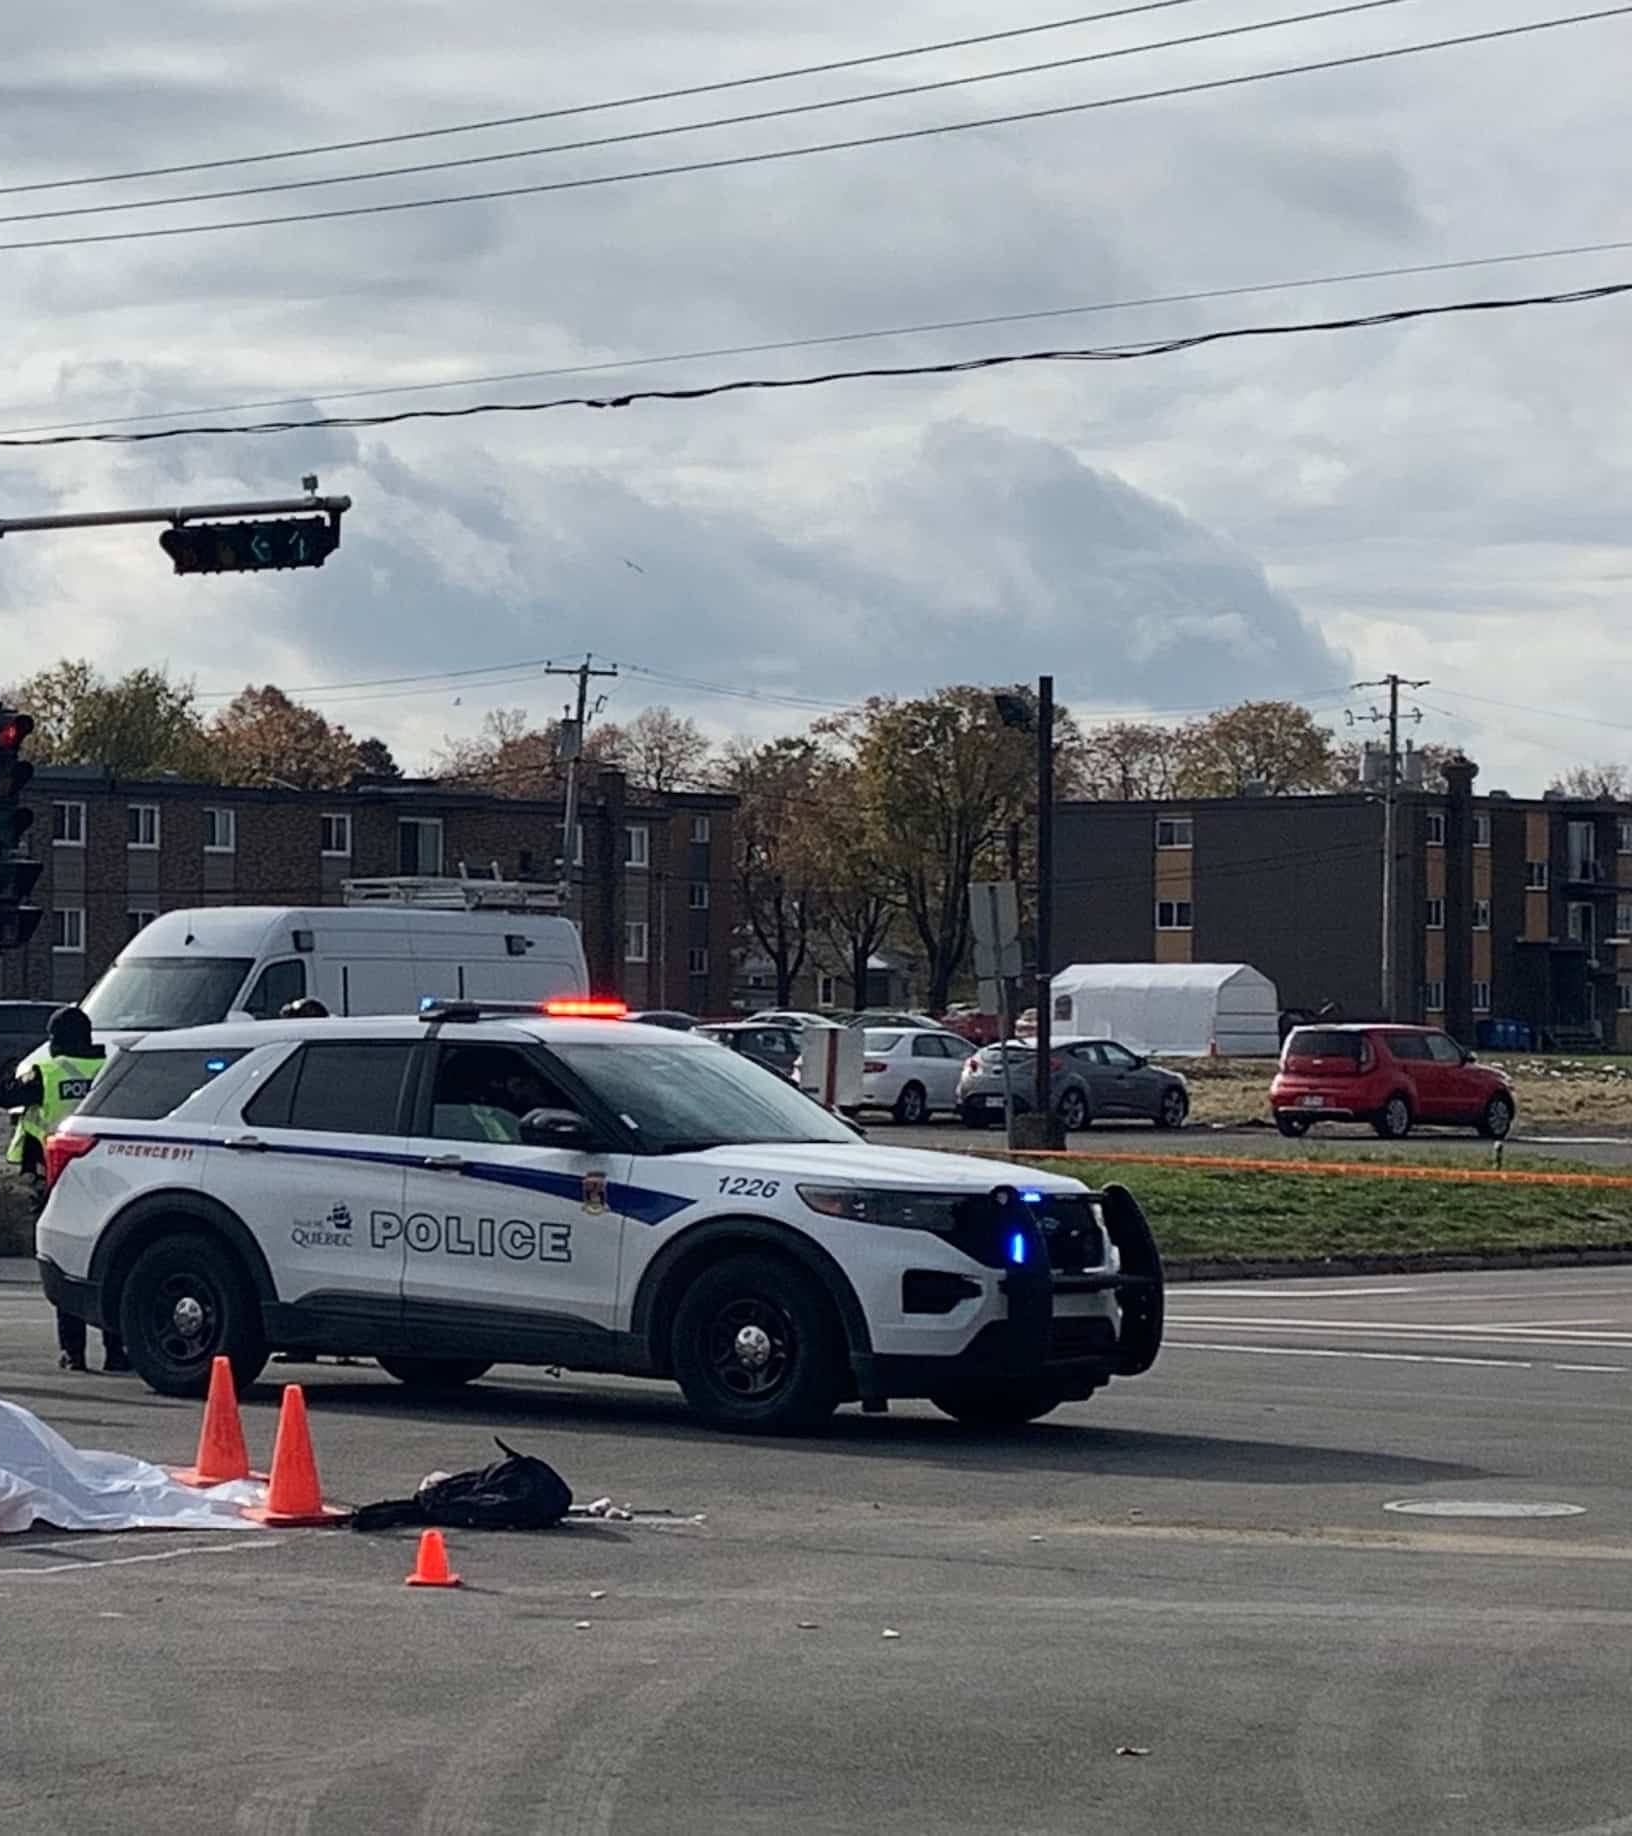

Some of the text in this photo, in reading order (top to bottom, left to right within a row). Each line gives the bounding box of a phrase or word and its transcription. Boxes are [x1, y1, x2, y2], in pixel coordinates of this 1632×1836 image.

[108, 1143, 194, 1161] URGENCE 911
[718, 1176, 781, 1198] 1226
[370, 1211, 572, 1262] POLICE
